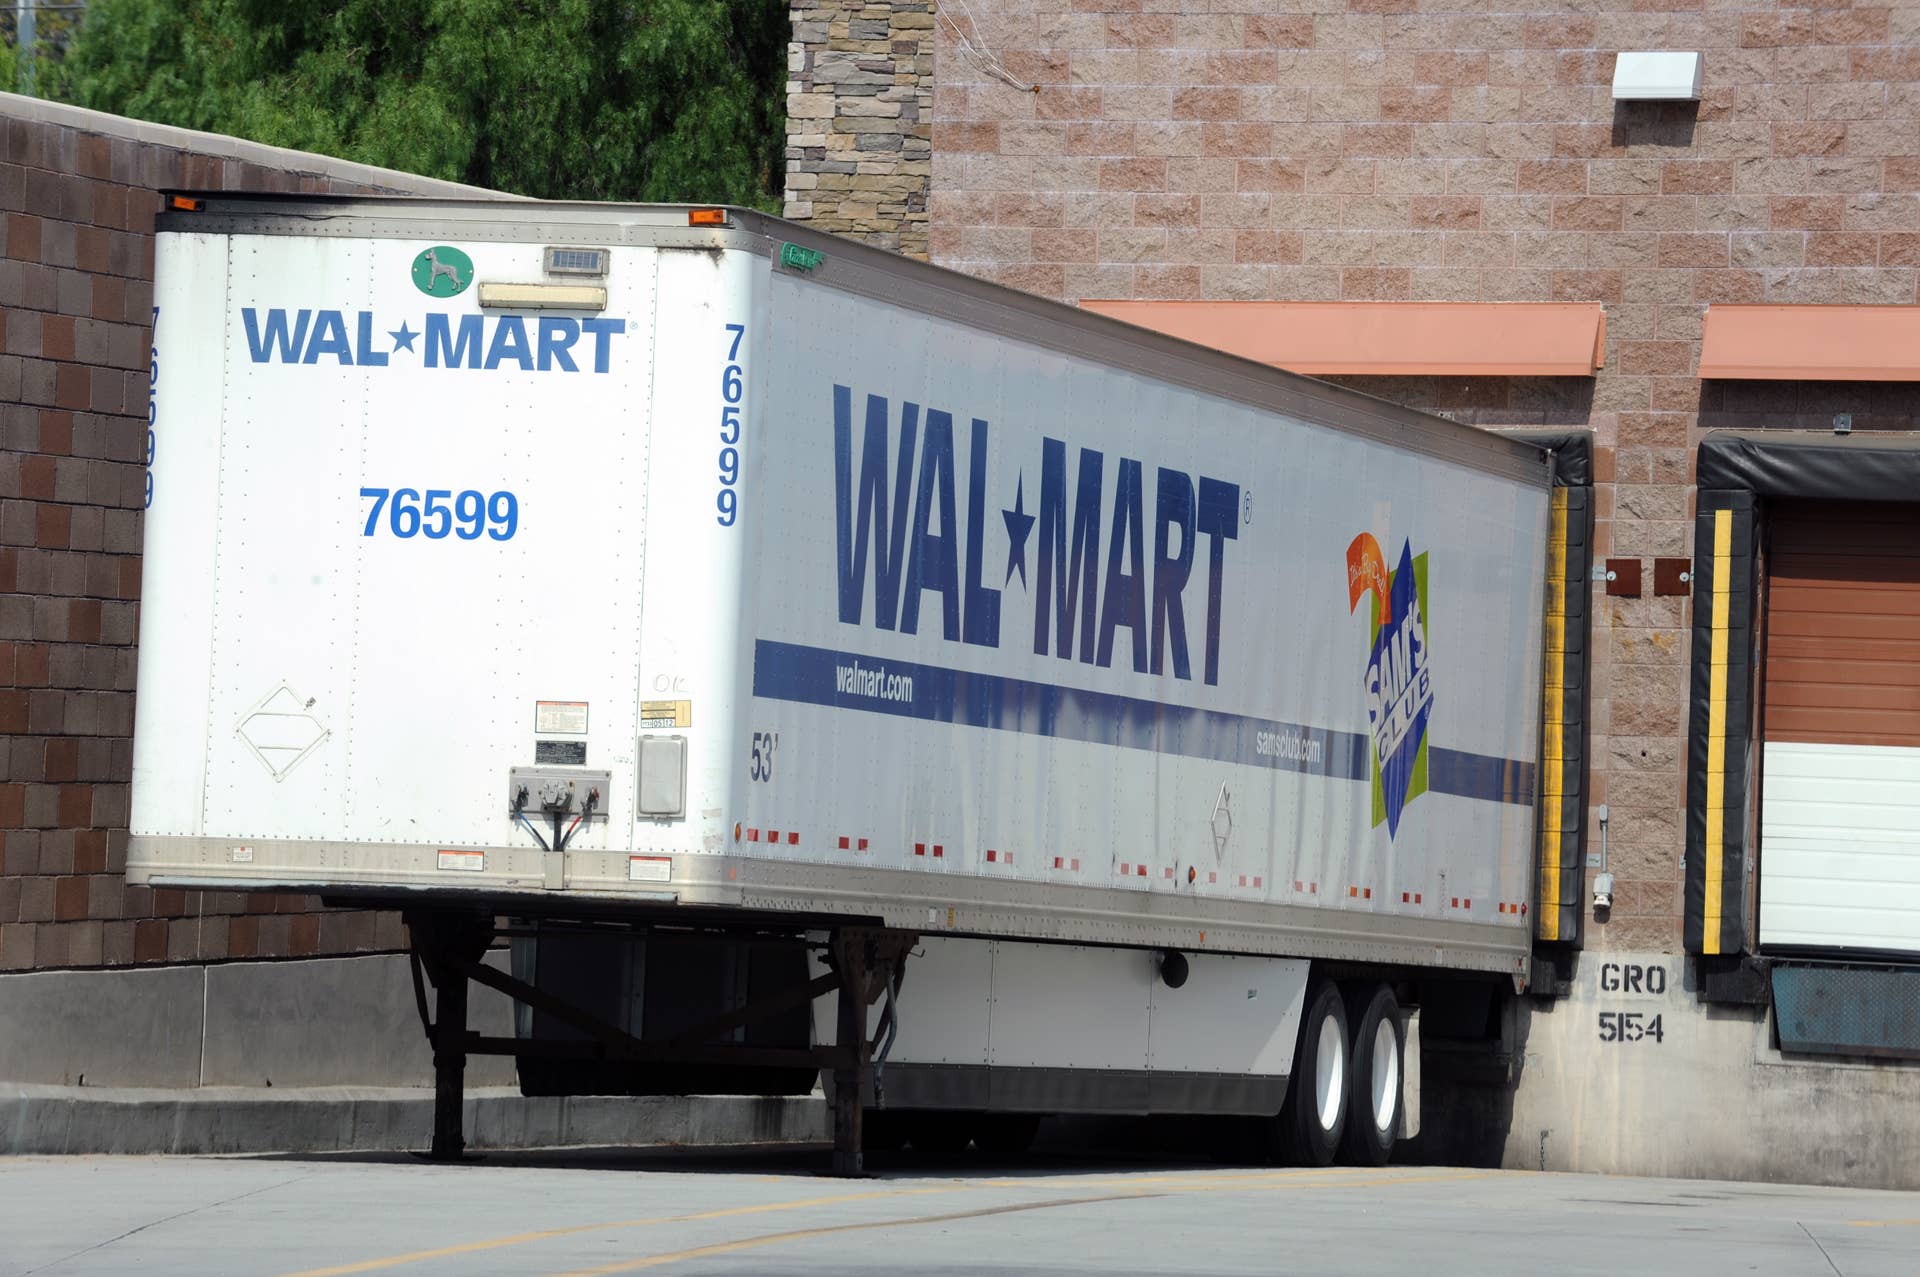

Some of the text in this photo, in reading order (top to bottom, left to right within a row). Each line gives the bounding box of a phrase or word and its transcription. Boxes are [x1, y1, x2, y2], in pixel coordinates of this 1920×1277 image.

[360, 488, 519, 541] 76599
[836, 660, 913, 703] walmart.com
[1366, 595, 1429, 734] SAM'S
[1378, 667, 1431, 762] CLUB
[1256, 729, 1321, 763] samsclub.com
[1601, 963, 1666, 994] GRO
[1599, 1012, 1664, 1043] 5154
